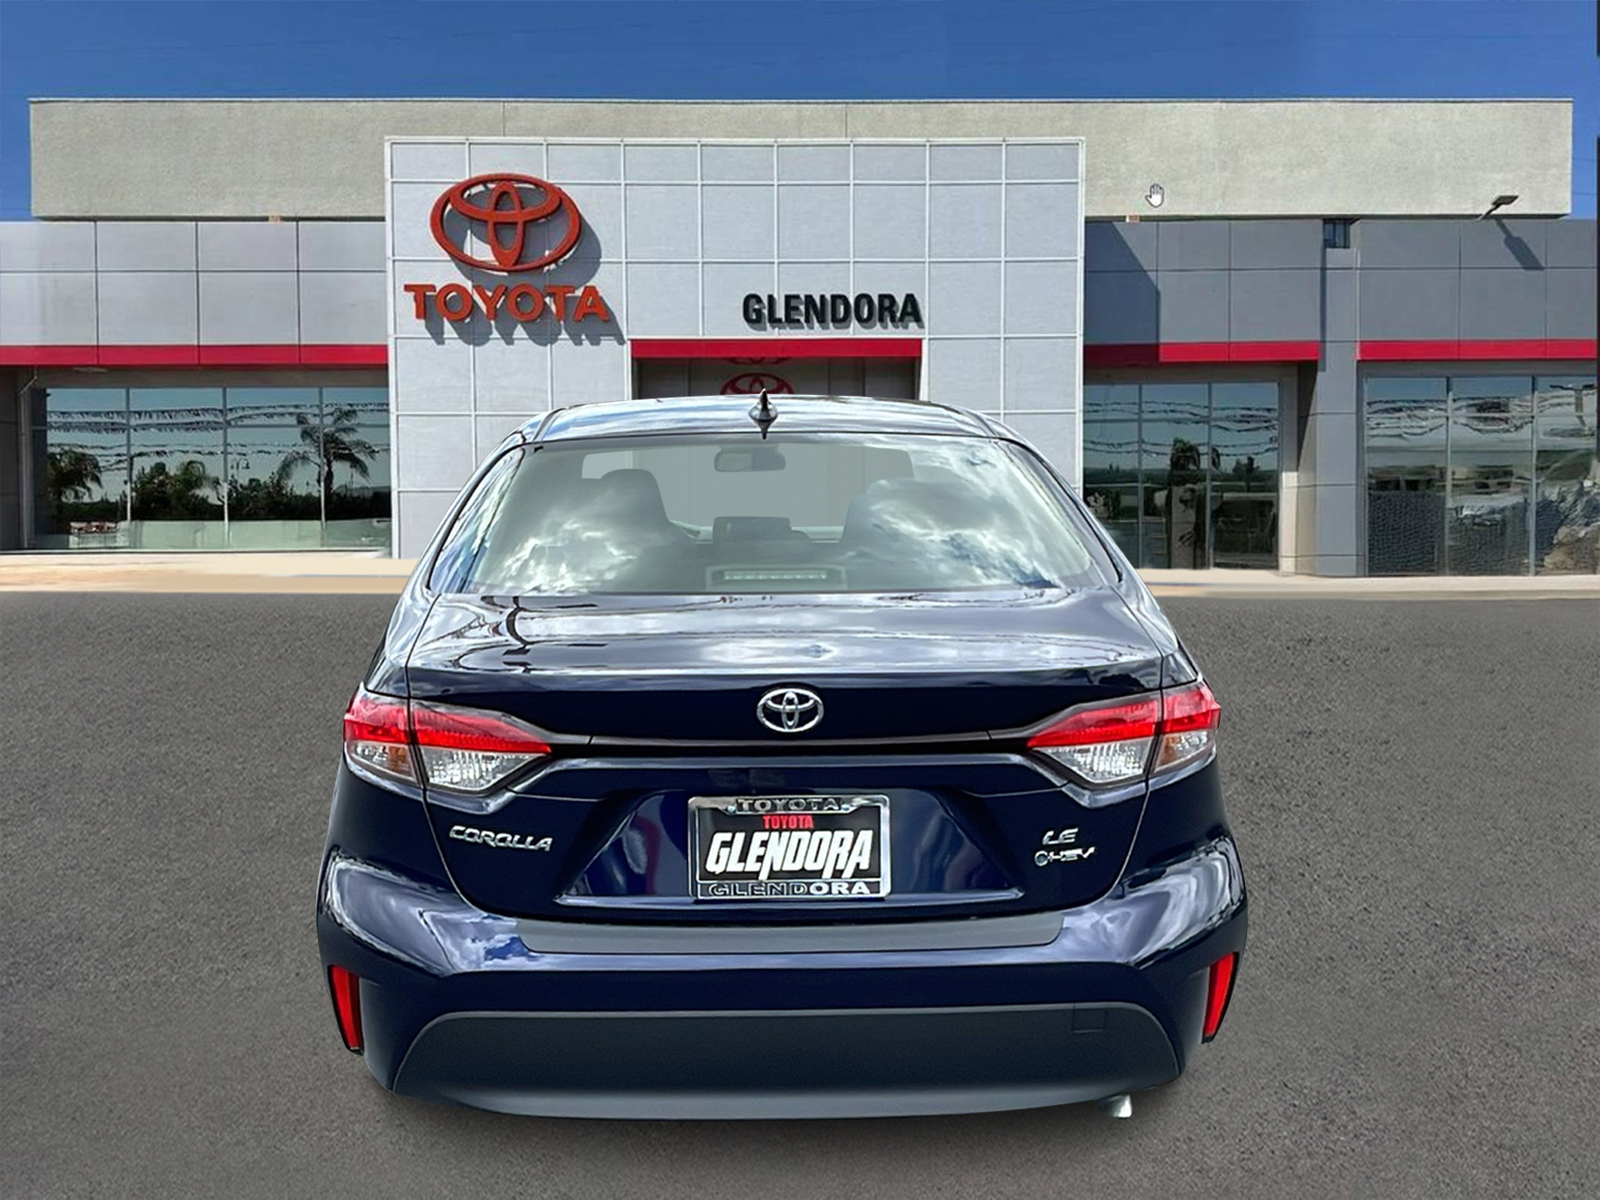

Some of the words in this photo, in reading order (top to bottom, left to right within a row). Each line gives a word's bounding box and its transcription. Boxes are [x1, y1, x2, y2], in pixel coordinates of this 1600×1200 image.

[404, 284, 610, 322] TOYOTA
[742, 293, 922, 325] GLENDORA
[737, 798, 841, 812] TOYOTA
[763, 815, 814, 829] TOYOTA
[449, 825, 553, 852] COROLLA
[1042, 827, 1079, 845] LE
[705, 830, 873, 881] GLENDORA
[708, 881, 871, 896] GLENDORA
